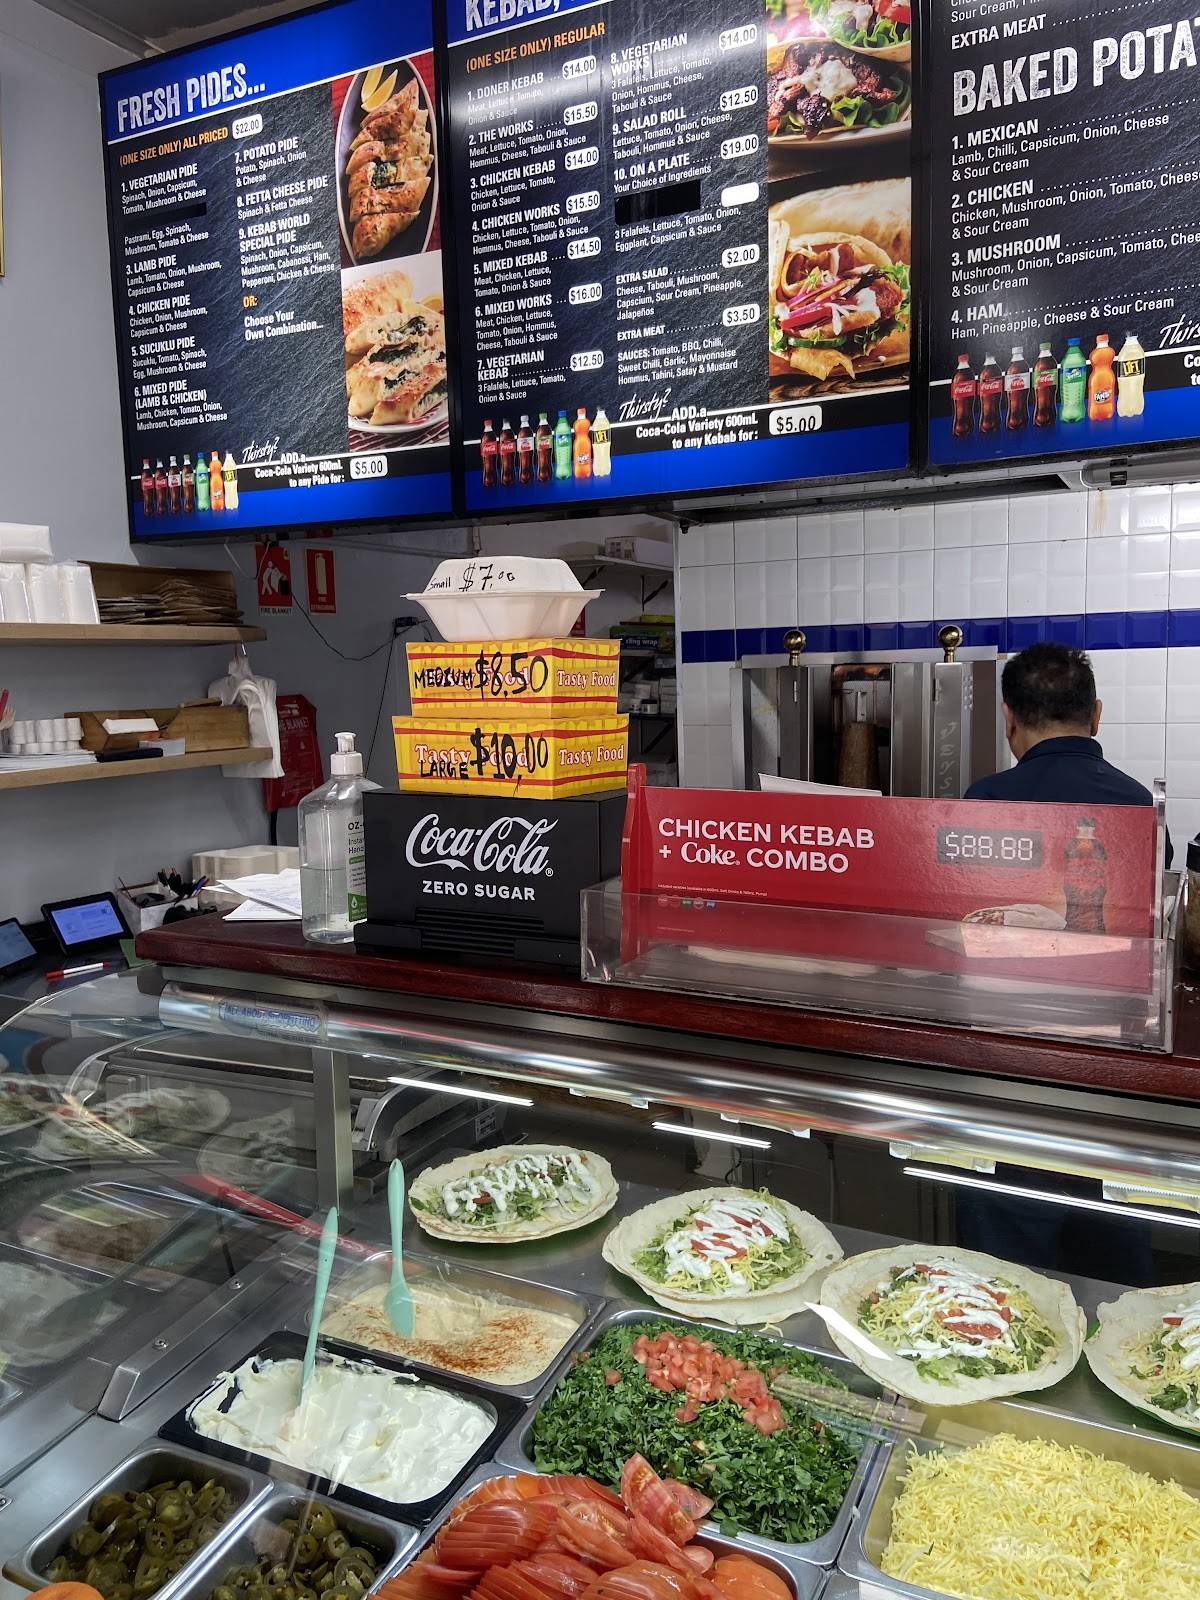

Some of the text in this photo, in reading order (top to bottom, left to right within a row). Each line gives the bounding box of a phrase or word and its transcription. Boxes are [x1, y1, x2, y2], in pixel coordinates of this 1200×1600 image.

[952, 9, 976, 22] Sour
[980, 1, 1019, 16] Cream,
[952, 14, 1046, 49] EXTRA MEAT
[466, 22, 605, 73] (ONE SIZE ONLY) REGULAR
[953, 46, 1078, 116] BAKED
[118, 63, 266, 132] FRESH PIDES...
[612, 89, 757, 135] 9. SALAD ROLL $12.50
[120, 119, 259, 167] (ONE SIZE ONLY) ALL PRICED $22.00
[952, 119, 1038, 150] 1. MEXICAN
[952, 115, 1169, 166] Lamb, Chilli, Capsicum, Onion, Cheese
[234, 137, 299, 164] 7. POTATO PIDE
[235, 151, 307, 175] Potato, Spinach, Onion
[614, 137, 757, 181] 10. ON A PLATE $19.00
[122, 163, 198, 193] 1. VEGETARIAN PIDE
[236, 173, 266, 188] & Cheese
[470, 150, 598, 189] 3. CHICKEN KEBAB $14.00
[952, 159, 1029, 182] & Sour Cream
[237, 176, 328, 208] 8. FETTA CHEESE PIDE
[471, 175, 557, 201] Chicken, Lettuce, Tomato,
[951, 179, 1033, 209] 2. CHICKEN
[472, 194, 599, 232] 4. CHICKEN WORKS $15.50
[474, 240, 600, 275] 5. MIXED KEBAB $14.50
[951, 235, 1061, 266] 3. MUSHROOM
[616, 249, 755, 285] EXTRA SALAD $2.00
[129, 295, 191, 316] 4. CHICKEN PIDE
[243, 296, 257, 307] OR:
[475, 286, 601, 317] 6. MIXED WORKS $16.00
[951, 304, 1003, 324] 4. HAM
[617, 308, 755, 341] EXTRA MEAT $3.50
[951, 298, 1174, 340] Ham, Pineapple, Cheese & Sour Cream
[477, 351, 545, 370] 7. VEGETARIAN
[618, 338, 725, 362] SAUCES: Tomato, BBQ, Chilli,
[478, 354, 602, 381] KEBAB $12.50
[134, 380, 187, 397] 6. MIXED PIDE
[135, 390, 207, 410] (LAMB & CHICKEN)
[619, 388, 672, 421] Thirsty?
[672, 406, 707, 421] ADD a
[636, 414, 816, 439] Coca-Cola Variety 600mL $5.00
[672, 431, 758, 449] to any Kebab for:
[355, 460, 383, 476] $5.00
[427, 577, 451, 591] Small
[642, 639, 657, 647] wrap
[557, 670, 616, 688] Tasty Food
[416, 745, 470, 766] Tasty
[558, 744, 624, 766] Tasty Food
[420, 760, 469, 779] LARGE
[405, 814, 558, 875] Coca-Cola
[658, 818, 875, 848] CHICKEN KEBAB
[659, 842, 848, 873] + Coke COMBO
[422, 880, 535, 900] ZERO SUGAR
